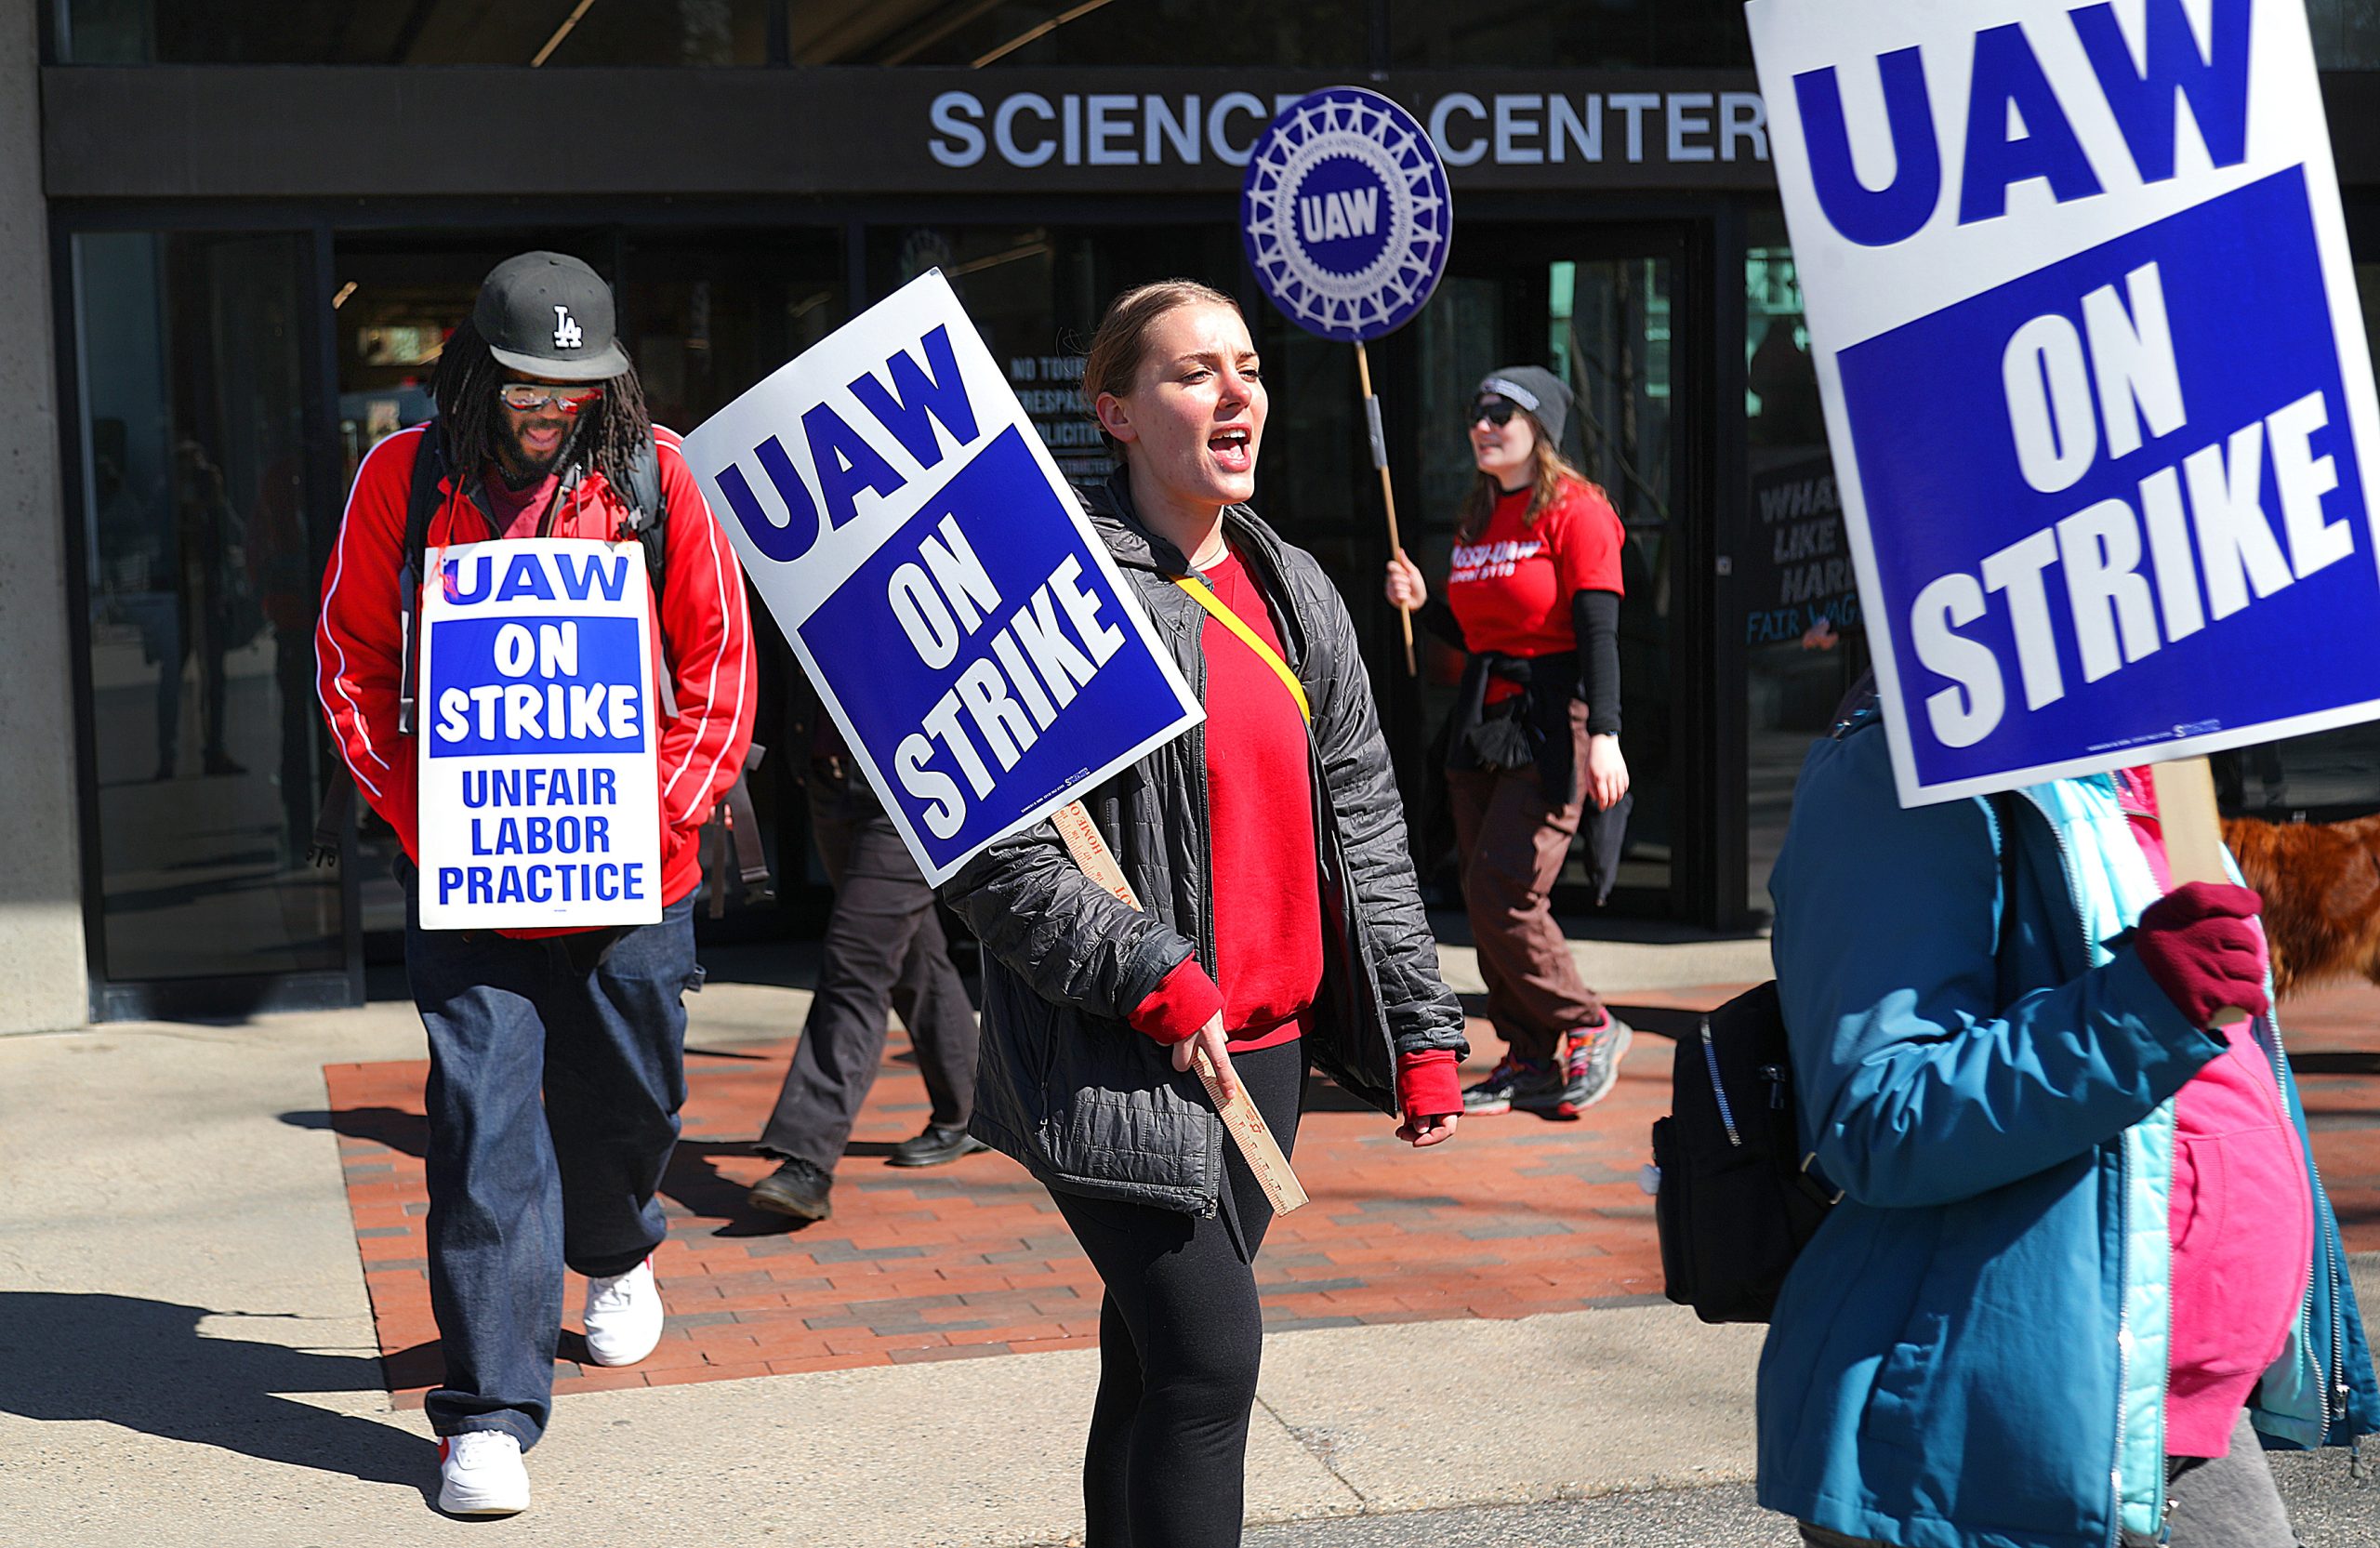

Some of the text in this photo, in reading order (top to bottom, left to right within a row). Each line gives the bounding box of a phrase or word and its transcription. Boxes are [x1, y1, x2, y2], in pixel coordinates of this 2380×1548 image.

[1429, 91, 1768, 167] CENTER
[1792, 0, 2253, 246] UAW
[1301, 187, 1378, 244] UAW
[553, 305, 582, 348] LA
[1011, 356, 1037, 381] NO
[2002, 260, 2187, 494] ON
[714, 323, 980, 562] UAW
[1759, 475, 1841, 523] WHA
[1774, 516, 1838, 564] LIKE
[443, 553, 628, 605] UAW
[888, 512, 1002, 670] ON
[1910, 390, 2354, 748] STRIKE
[1745, 593, 1858, 645] FAIR WAG
[494, 621, 578, 679] ON
[435, 681, 640, 743] STRIKE
[893, 552, 1127, 840] STRIKE
[462, 768, 616, 808] UNFAIR
[471, 816, 609, 855] LABOR
[1077, 818, 1103, 855] HOME
[438, 863, 644, 905] PRACTICE
